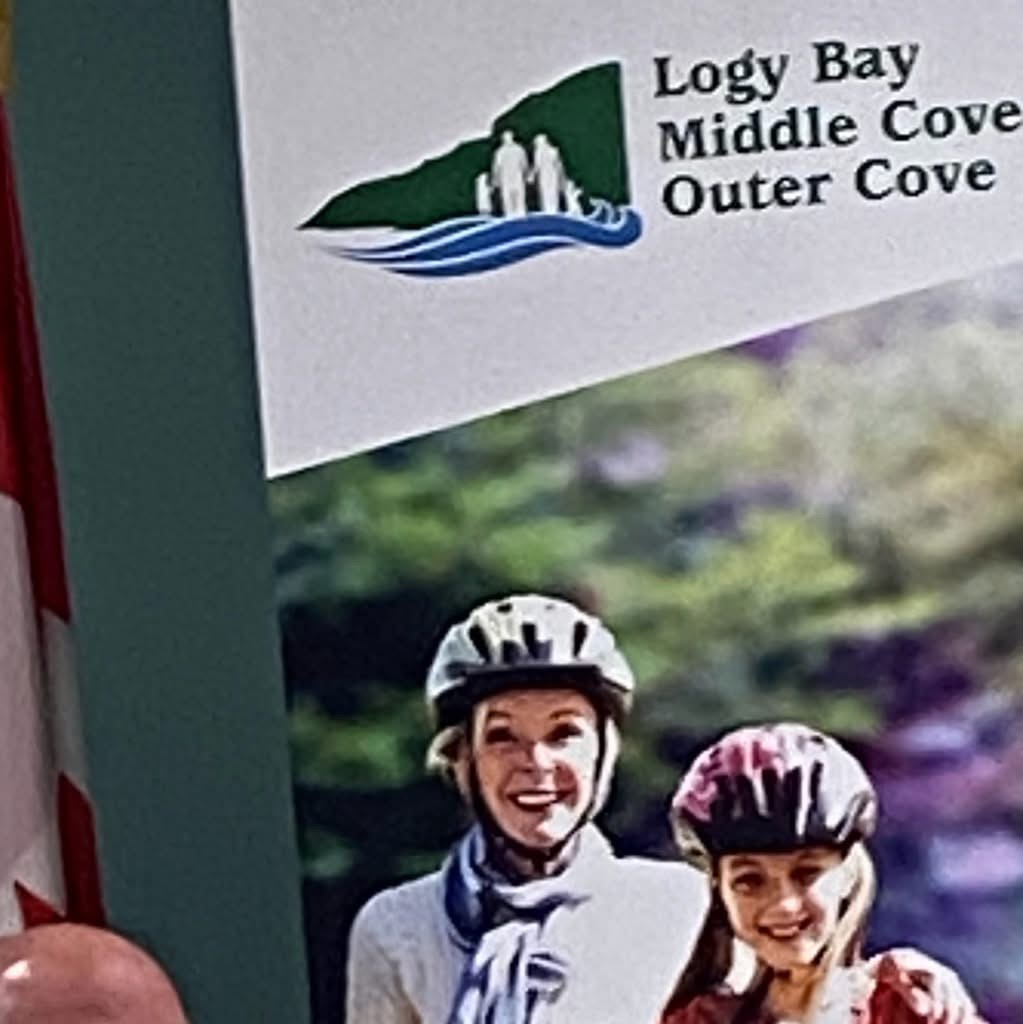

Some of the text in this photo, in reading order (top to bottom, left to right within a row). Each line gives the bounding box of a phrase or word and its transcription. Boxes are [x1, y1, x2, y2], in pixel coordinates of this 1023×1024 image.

[653, 40, 921, 105] Logy Bay
[657, 98, 1022, 162] Middle Cove
[662, 157, 997, 216] Outer Cove
